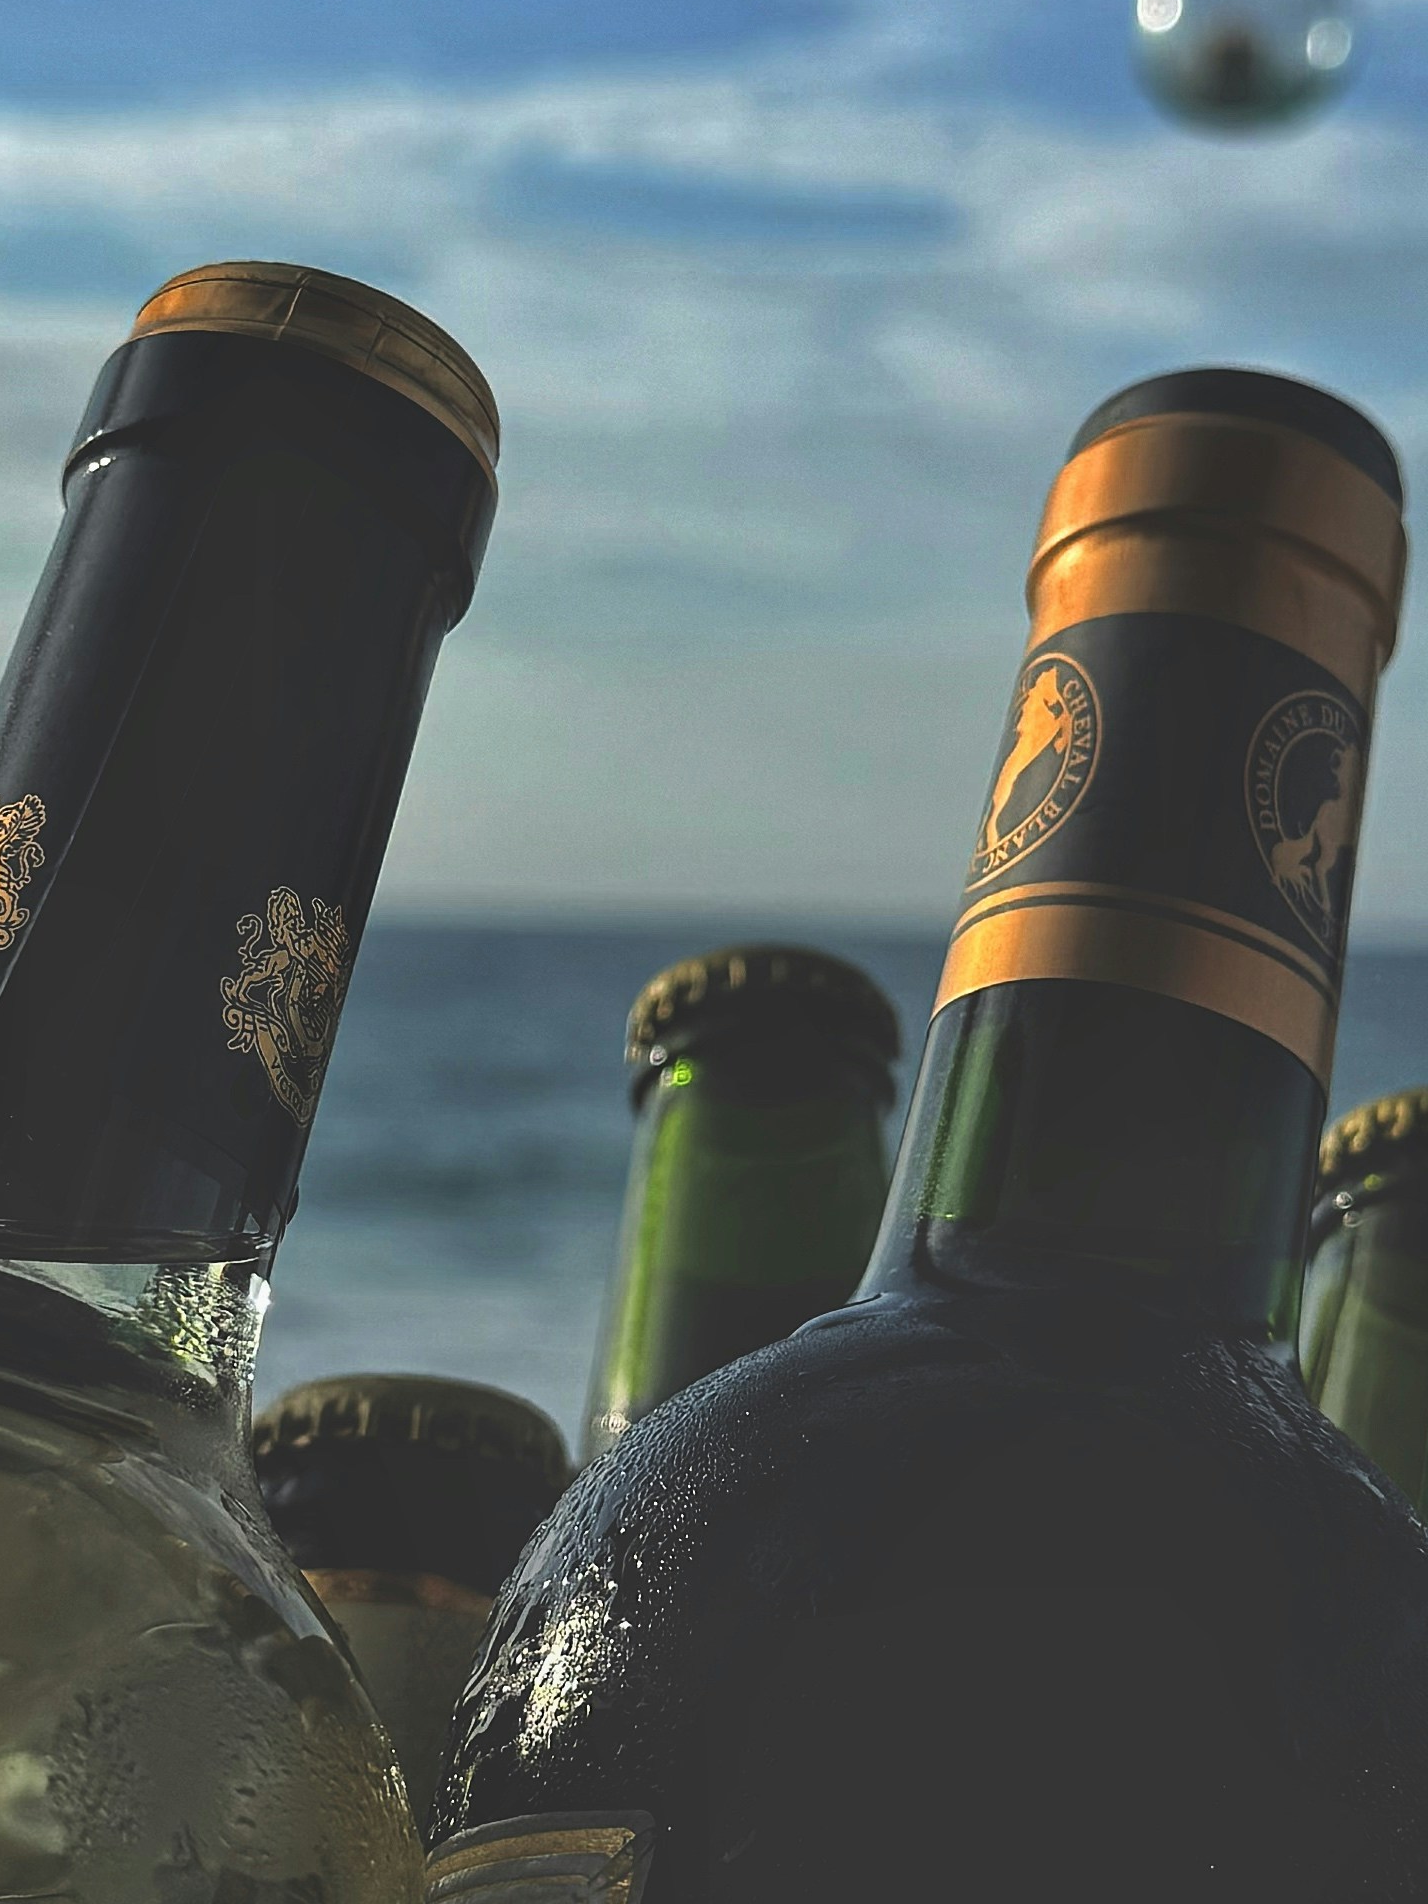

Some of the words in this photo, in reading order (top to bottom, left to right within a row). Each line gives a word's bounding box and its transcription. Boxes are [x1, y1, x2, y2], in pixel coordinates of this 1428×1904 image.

[1061, 678, 1092, 790] CHEVAL
[1253, 702, 1314, 831] DOMAINE
[980, 798, 1065, 875] BLANC
